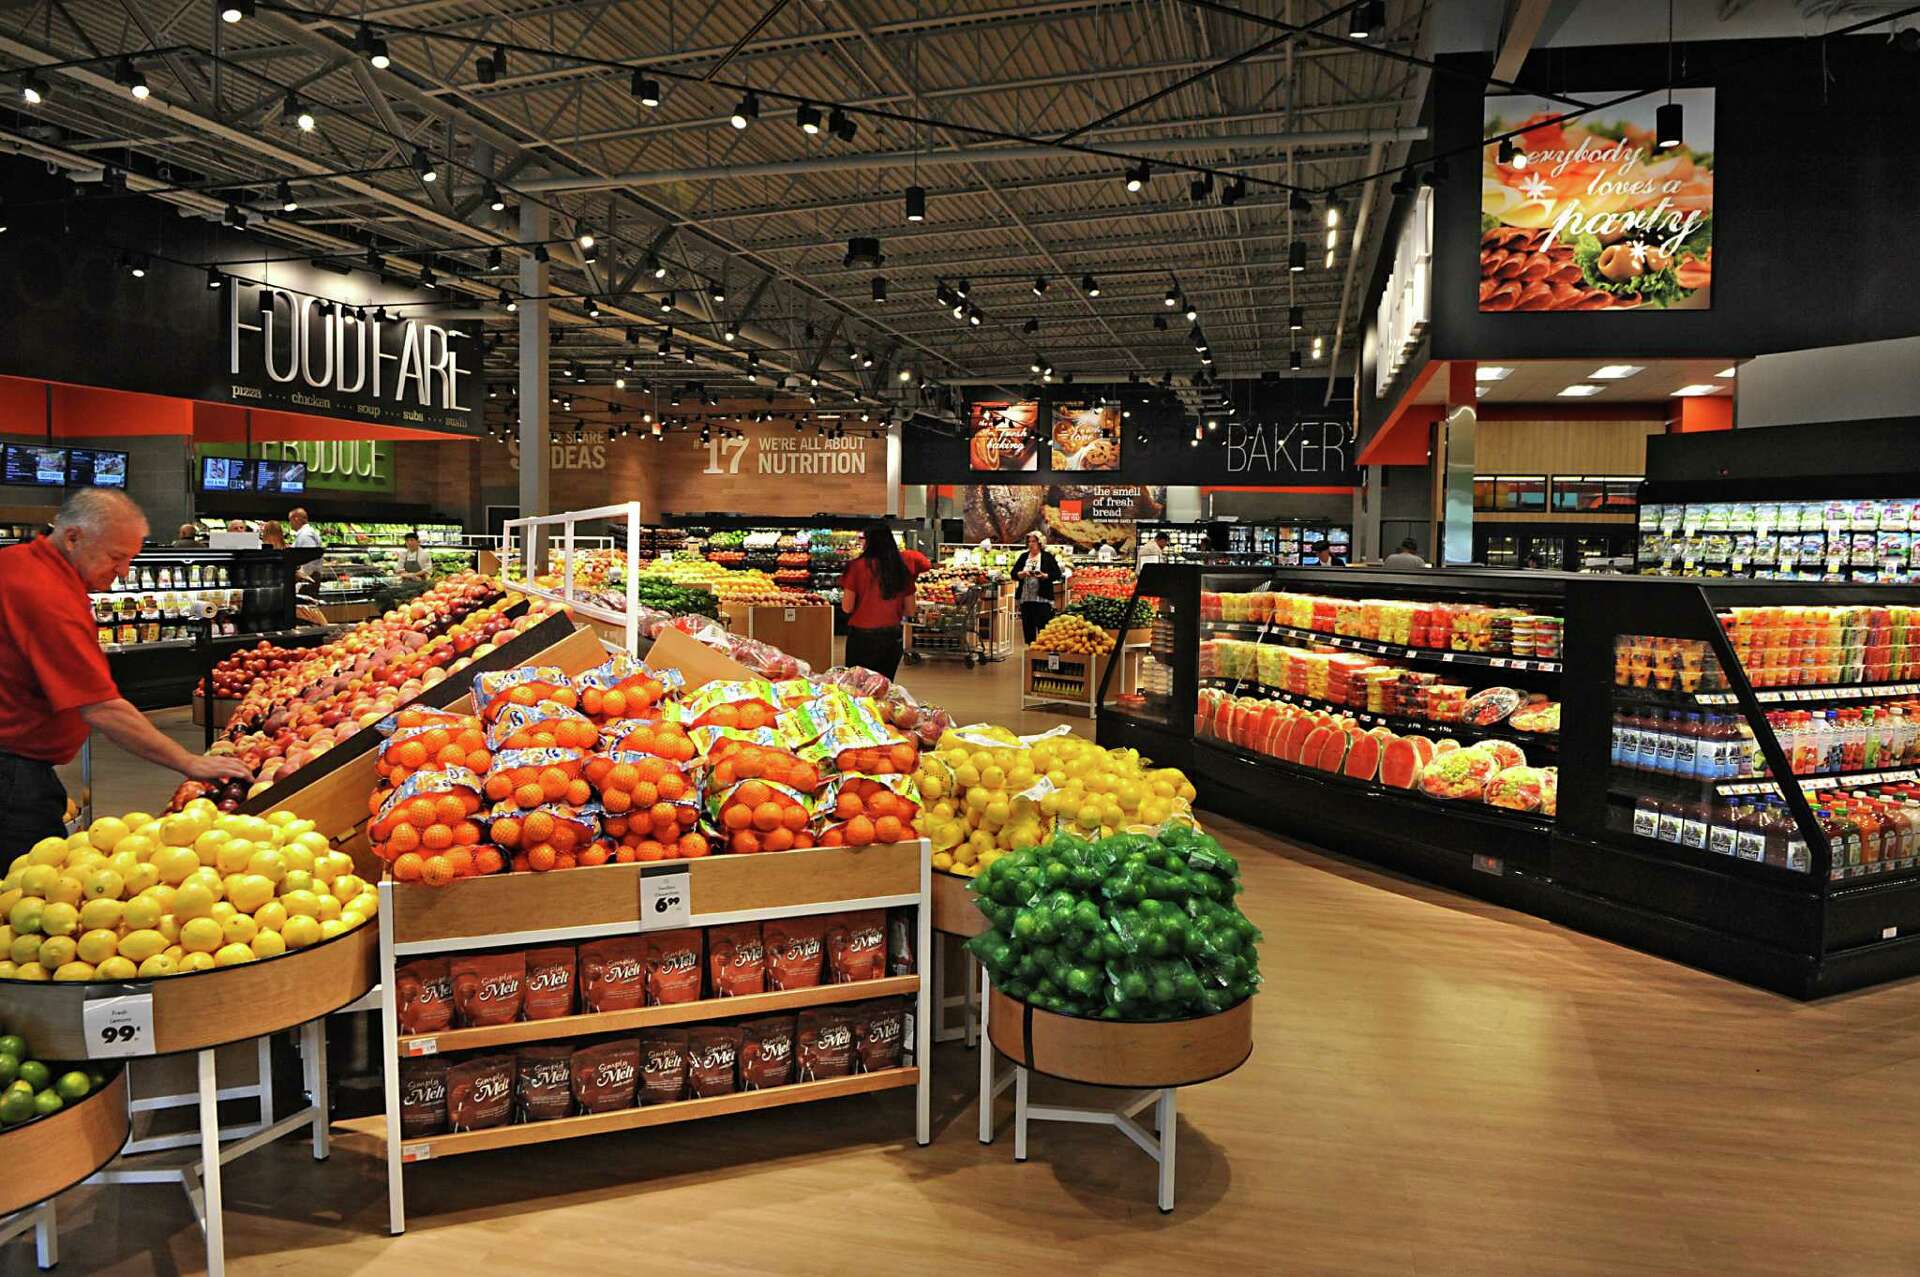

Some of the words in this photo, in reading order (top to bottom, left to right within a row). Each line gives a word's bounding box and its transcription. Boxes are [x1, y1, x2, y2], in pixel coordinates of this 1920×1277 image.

[1496, 136, 1644, 177] erybody
[1586, 169, 1656, 196] loves
[1663, 179, 1681, 193] a
[1538, 196, 1703, 259] party
[231, 384, 262, 399] pizza
[291, 392, 331, 409] chicken
[357, 403, 381, 417] soup
[402, 410, 424, 422] subs
[758, 437, 796, 450] WE'RE
[801, 437, 821, 450] ALL
[825, 436, 865, 450] ABOUT
[986, 437, 1025, 456] baking
[1228, 422, 1352, 472] BAKER
[551, 445, 606, 469] DEAS
[758, 452, 866, 474] NUTRITION
[1094, 486, 1110, 496] the
[1112, 486, 1141, 496] smell
[1093, 497, 1103, 507] of
[1106, 497, 1134, 507] fresh
[1093, 508, 1121, 517] bread
[787, 943, 820, 961] Melt
[850, 934, 883, 952] Melt
[605, 963, 640, 983] Melt
[662, 953, 696, 974] Melt
[531, 970, 569, 990] Melt
[479, 981, 519, 1001] Melt
[869, 1023, 900, 1042] Melt
[645, 1055, 682, 1073] Melt
[531, 1069, 570, 1088] Melt
[596, 1066, 634, 1087] Melt
[404, 1085, 445, 1106] Melt
[473, 1079, 510, 1103] Melt
